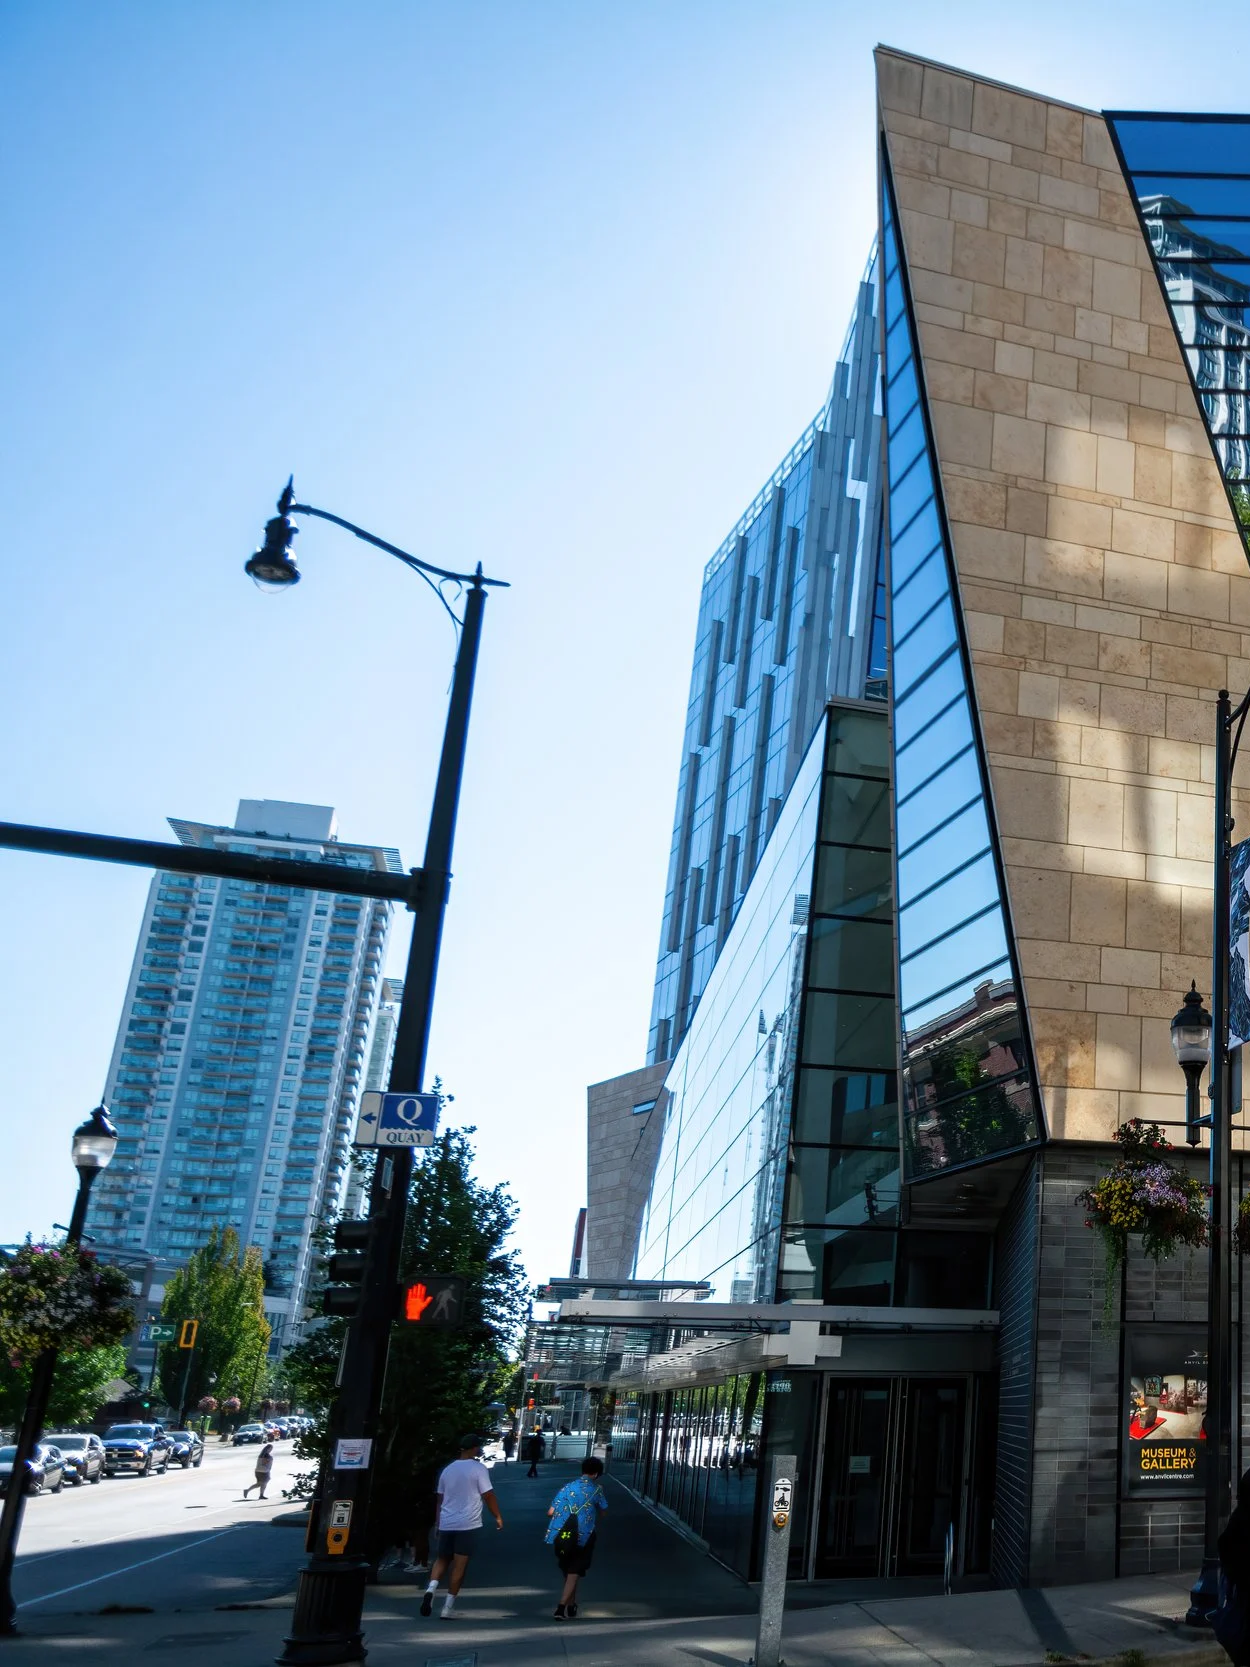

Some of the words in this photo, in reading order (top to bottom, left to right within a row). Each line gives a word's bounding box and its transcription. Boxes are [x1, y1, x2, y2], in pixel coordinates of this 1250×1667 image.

[397, 1098, 423, 1127] Q
[386, 1131, 424, 1144] QUAY
[149, 1326, 162, 1340] P
[1141, 1448, 1187, 1458] MUSEUM
[1189, 1447, 1196, 1458] &
[1141, 1458, 1196, 1470] GALLERY
